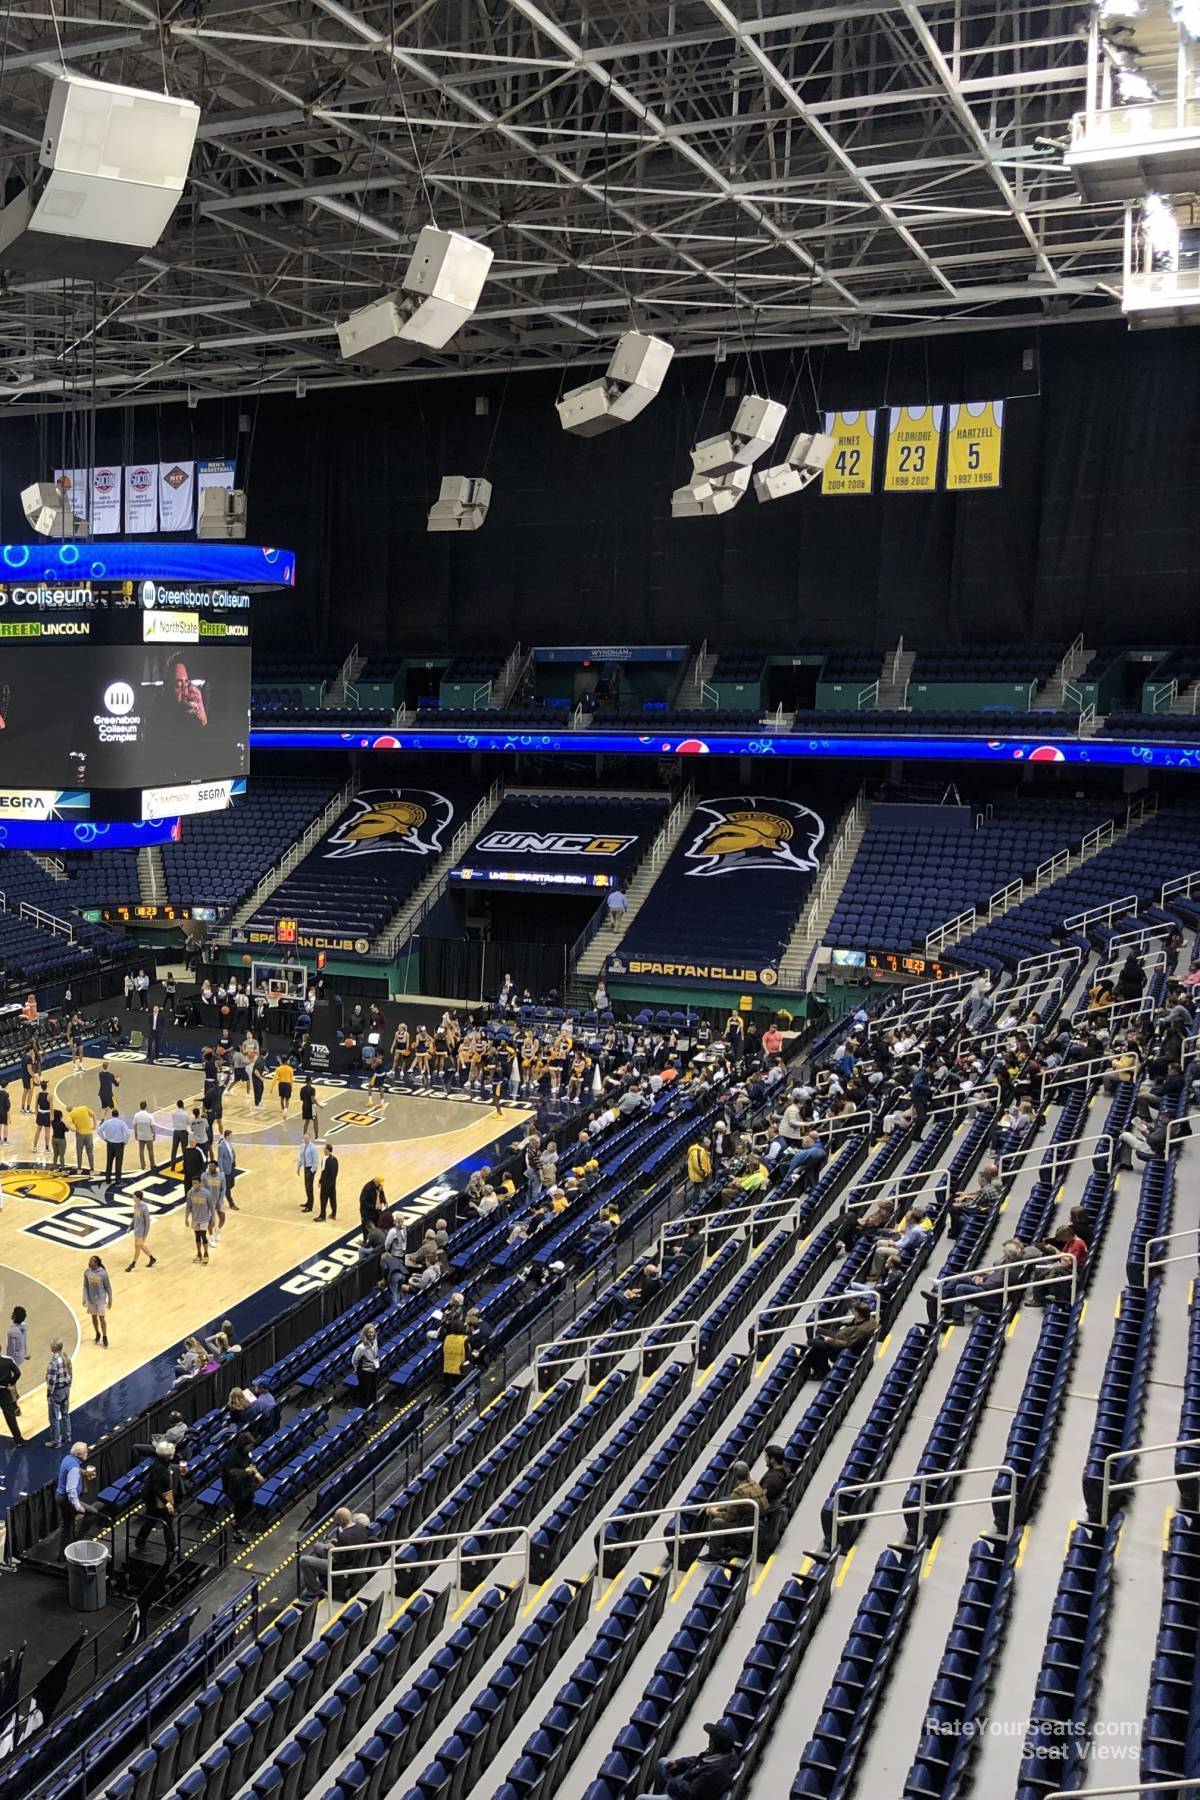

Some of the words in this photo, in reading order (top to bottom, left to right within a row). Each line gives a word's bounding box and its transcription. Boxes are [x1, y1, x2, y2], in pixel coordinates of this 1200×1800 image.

[897, 430, 932, 442] ELDRIDGE
[957, 427, 993, 440] HARTZELL
[838, 435, 860, 446] HINES
[835, 449, 861, 476] 42
[898, 445, 926, 472] 23
[967, 443, 980, 470] 5
[12, 587, 92, 604] Coliseum
[157, 586, 210, 607] Greensboro
[211, 591, 250, 608] Coliseum
[159, 620, 198, 634] NorthState
[93, 715, 141, 725] Greensboro
[98, 725, 138, 733] Coliseum
[98, 733, 137, 743] Complex
[198, 788, 226, 801] SEGRA
[480, 832, 631, 855] UNCG
[315, 939, 353, 951] CLUB
[629, 961, 708, 978] SPARTAN
[710, 967, 757, 982] CLUB
[310, 1043, 330, 1054] TFA
